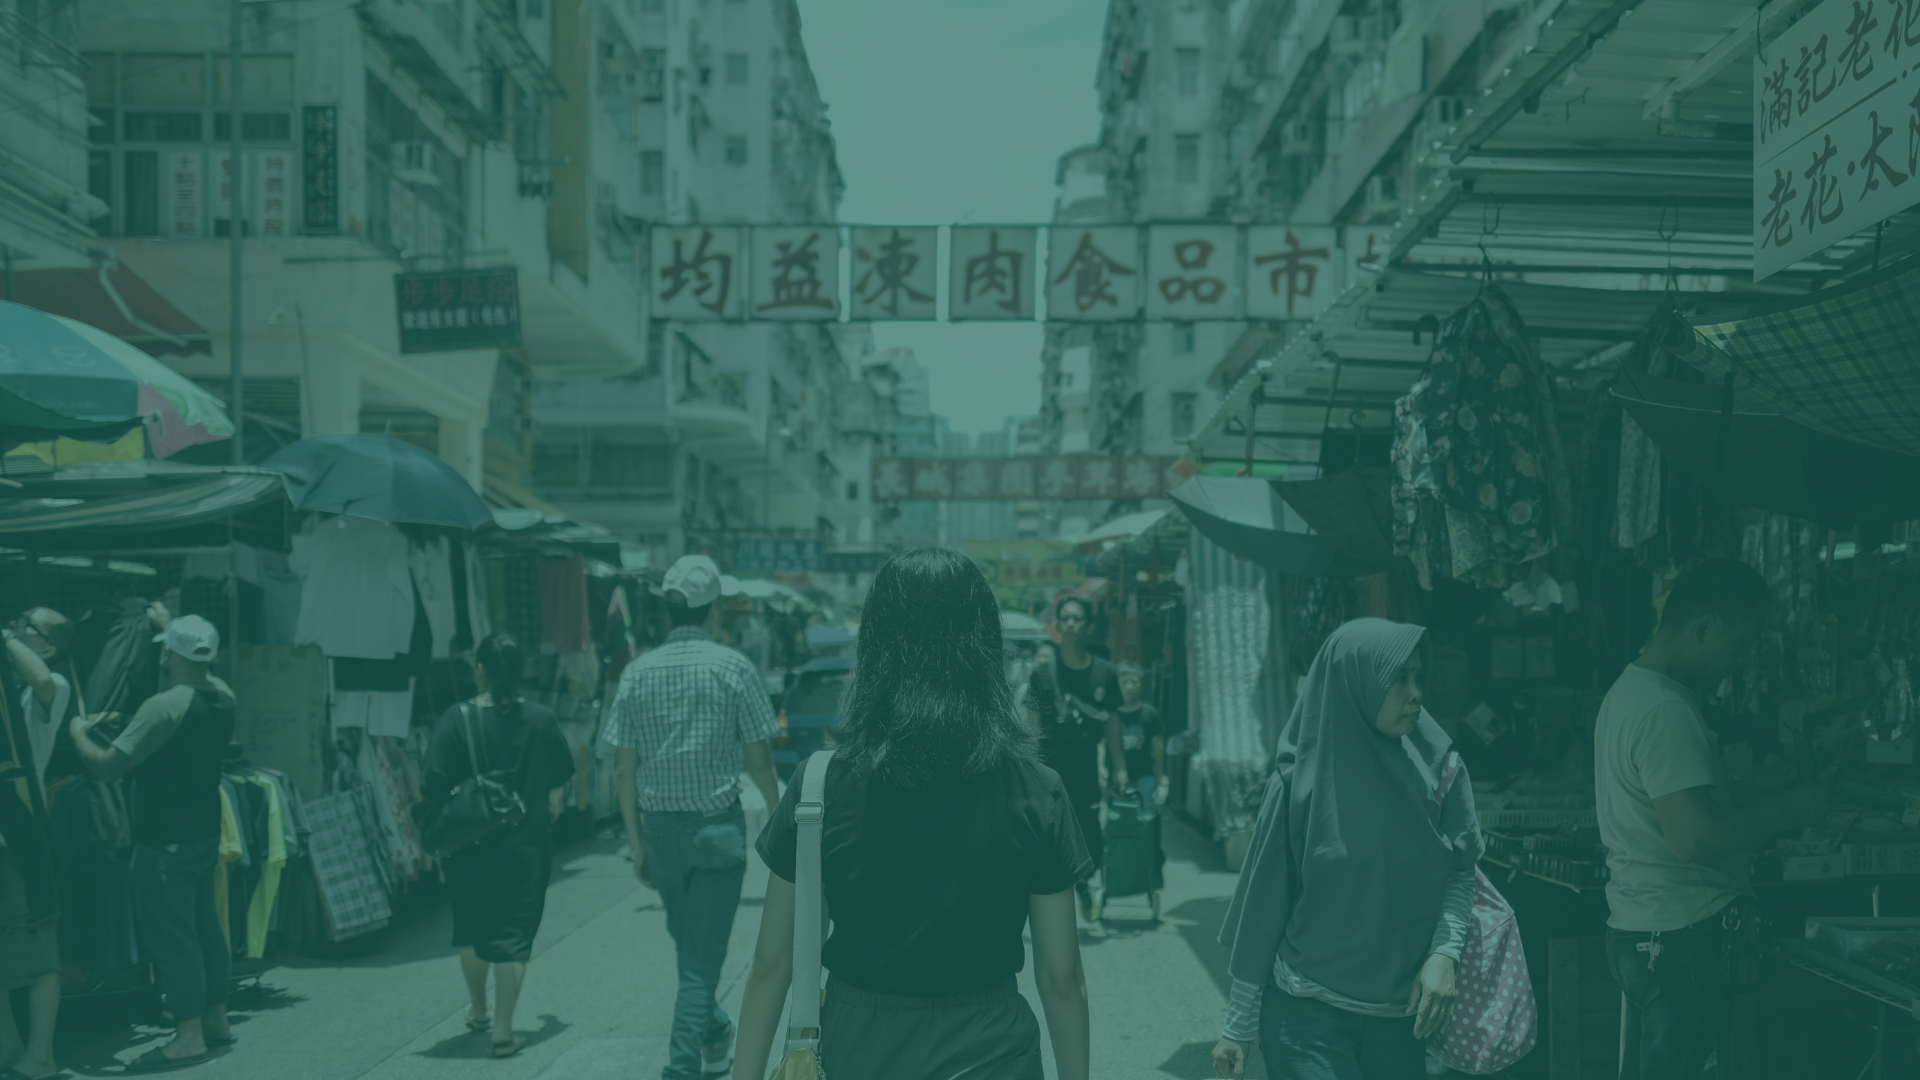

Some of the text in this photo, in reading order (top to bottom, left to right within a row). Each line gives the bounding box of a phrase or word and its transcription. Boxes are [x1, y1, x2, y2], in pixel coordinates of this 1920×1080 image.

[1760, 88, 1920, 249] 老花·太
[401, 276, 513, 309] 步步足浴
